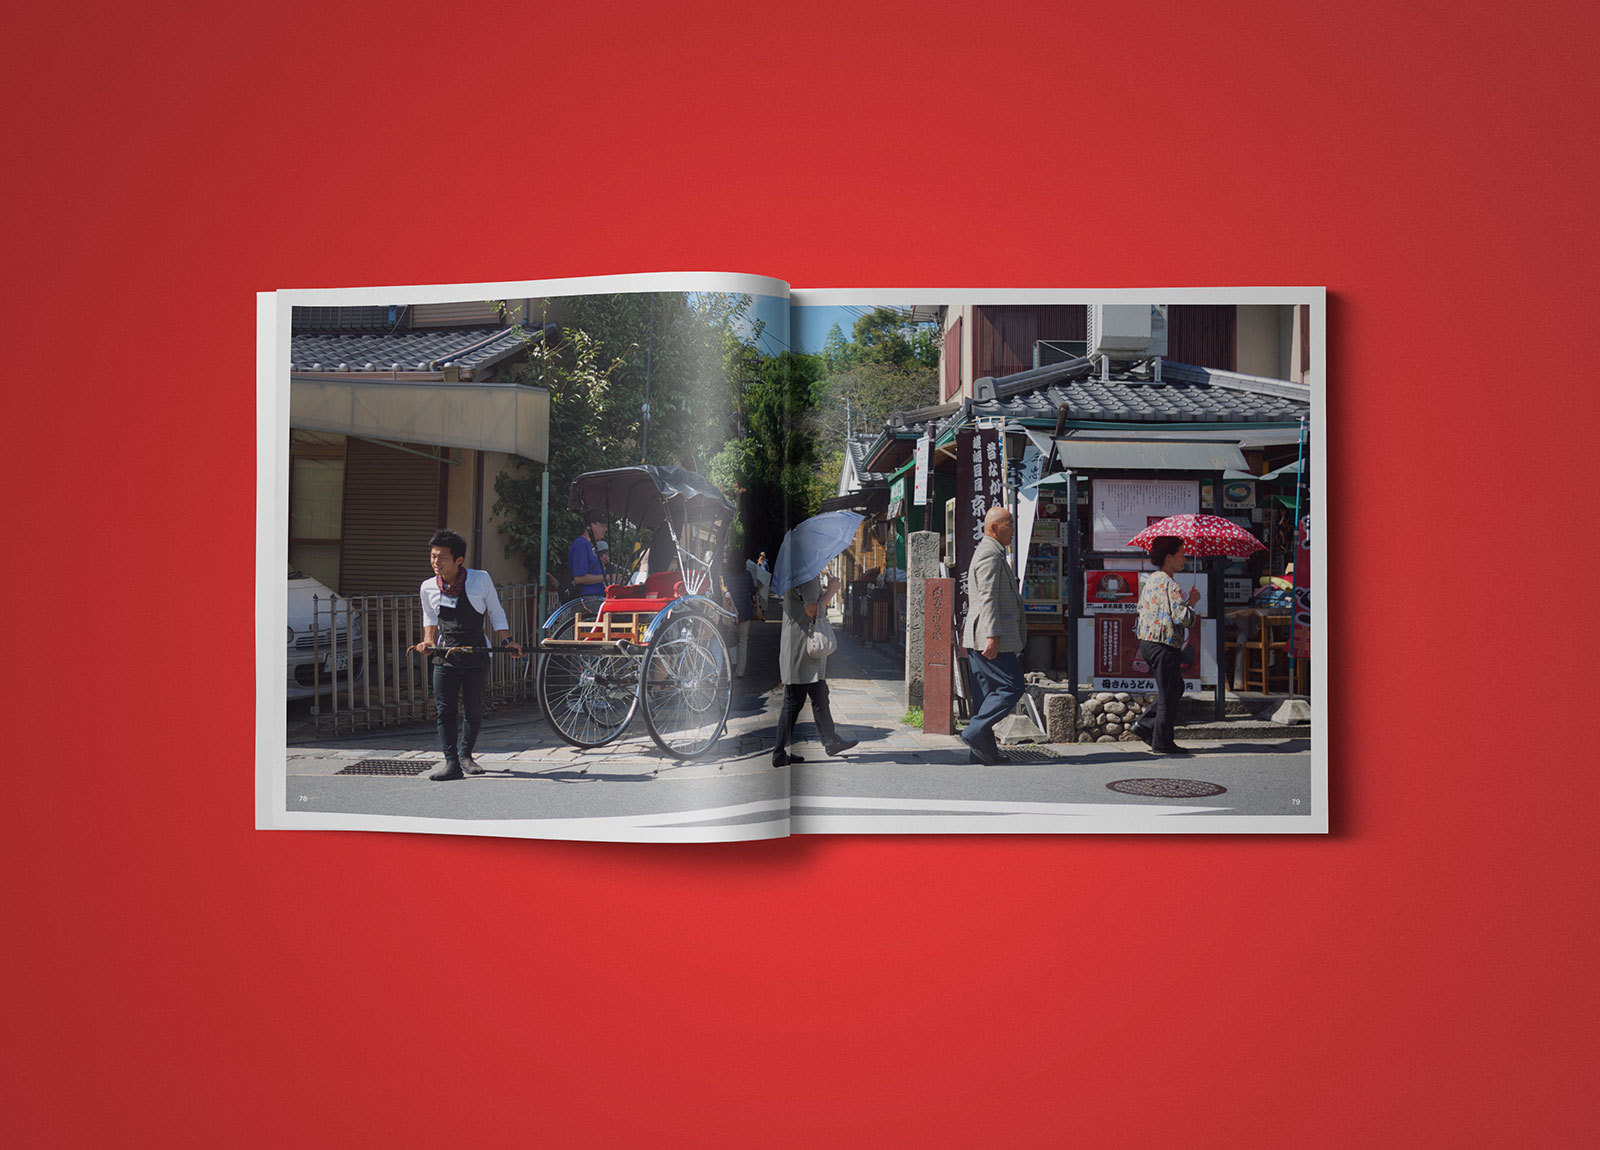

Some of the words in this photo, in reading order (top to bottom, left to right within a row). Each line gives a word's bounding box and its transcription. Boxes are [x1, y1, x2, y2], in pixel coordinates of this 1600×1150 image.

[1102, 678, 1155, 690] 母さんうどん
[1291, 798, 1301, 806] 79
